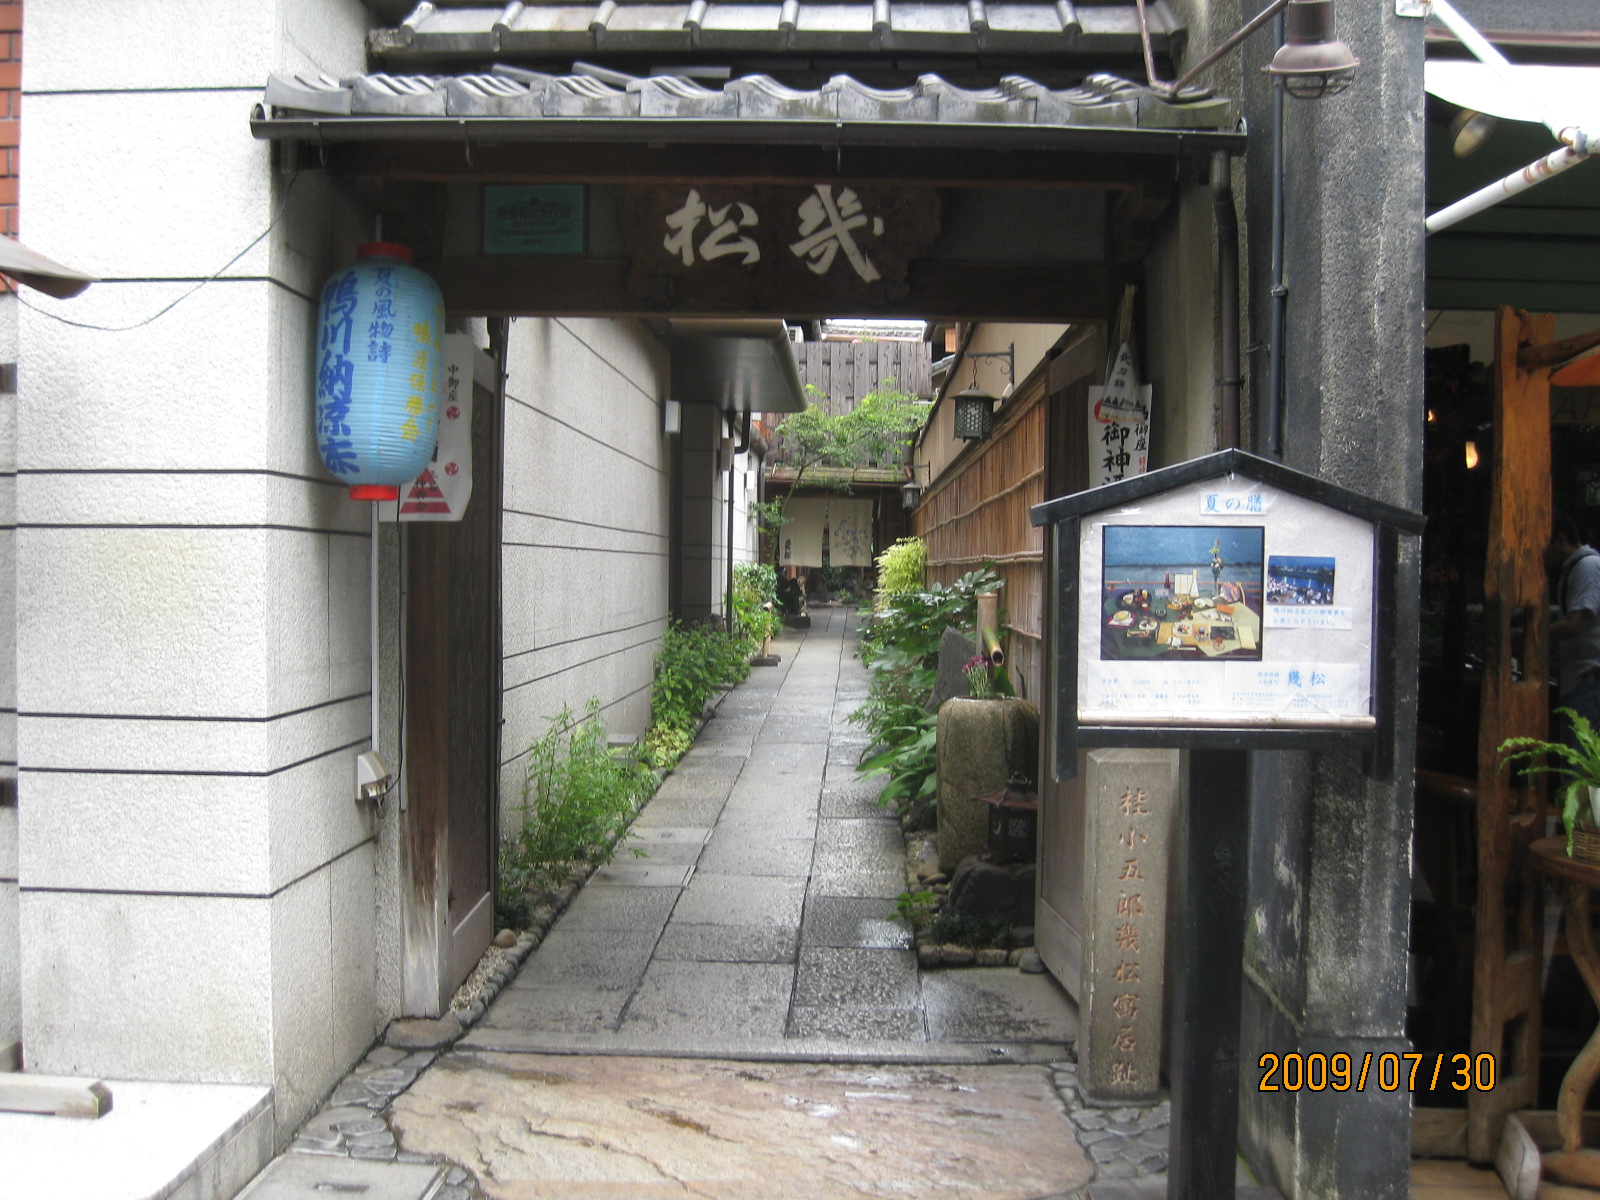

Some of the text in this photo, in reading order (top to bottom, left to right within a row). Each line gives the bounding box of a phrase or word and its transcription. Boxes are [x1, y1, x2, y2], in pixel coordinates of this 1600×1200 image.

[367, 265, 396, 364] 夏の風物詩
